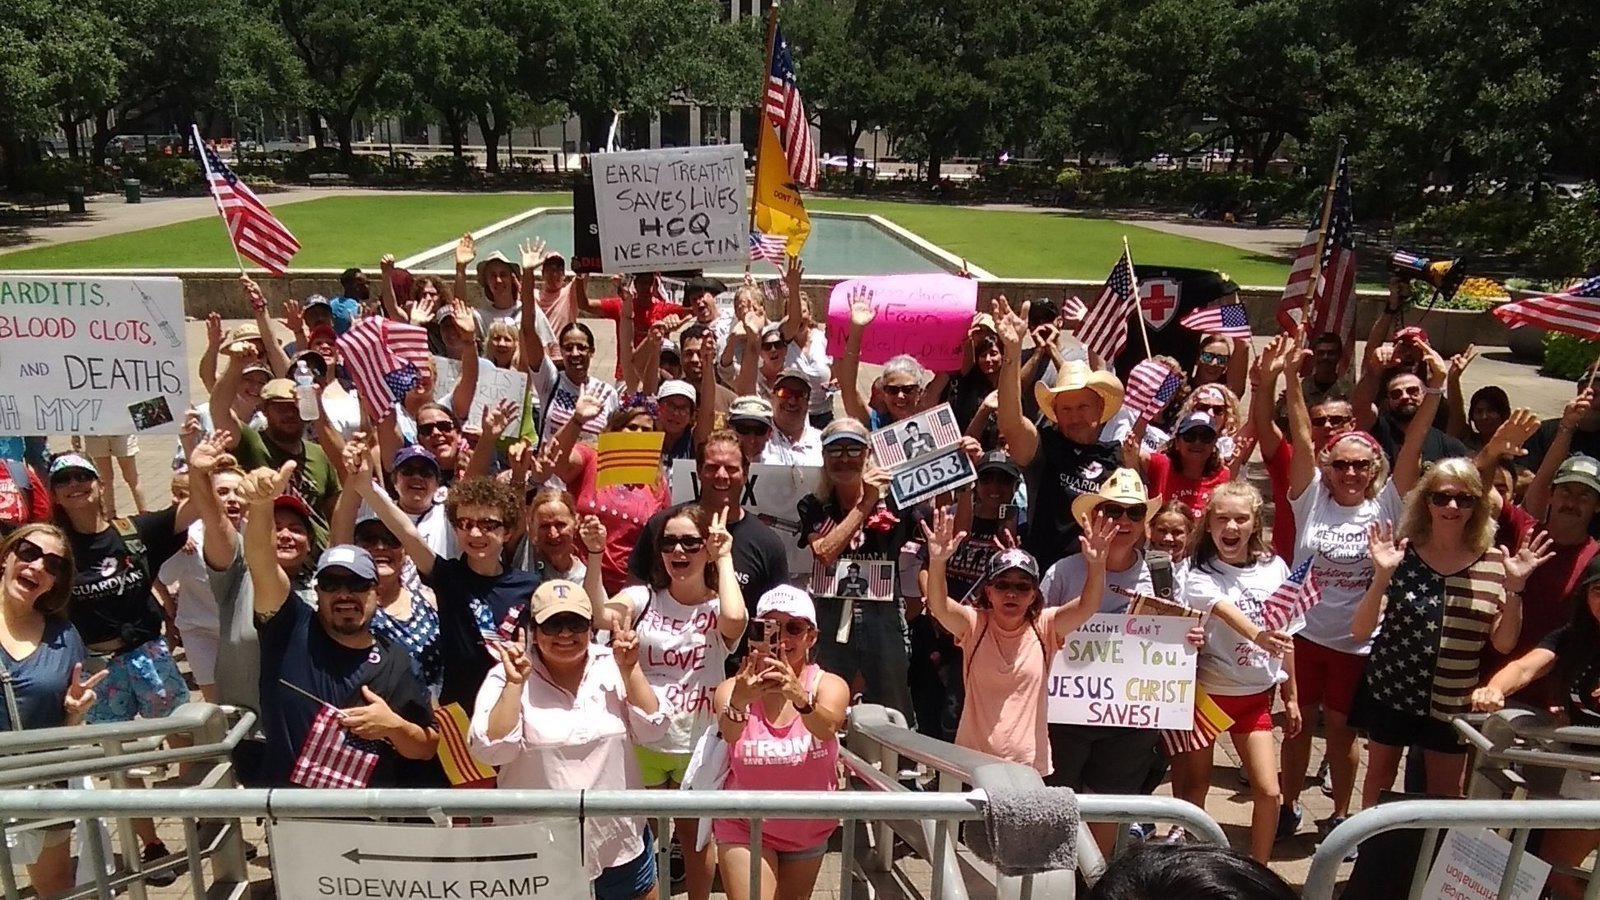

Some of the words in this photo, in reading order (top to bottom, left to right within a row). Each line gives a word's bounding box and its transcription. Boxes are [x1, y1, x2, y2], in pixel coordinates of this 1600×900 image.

[606, 163, 661, 185] EARLY
[616, 188, 688, 215] SAVES
[639, 212, 711, 239] HCQ
[613, 234, 740, 262] IVERMECTIN
[0, 316, 77, 339] BLOOD
[89, 319, 157, 346] CLOTS,
[19, 362, 50, 378] AND
[64, 354, 183, 395] DEATHS,
[0, 394, 21, 431] H
[34, 394, 103, 432] MY!
[901, 455, 961, 494] 7053
[1059, 472, 1101, 492] GUARDI
[72, 569, 144, 596] GUARDIANS
[647, 643, 707, 672] LOVE
[1068, 639, 1125, 664] SAVE
[1047, 675, 1115, 700] JESUS
[1124, 677, 1192, 704] CHRIST
[1086, 701, 1161, 728] SAVES!
[742, 733, 824, 758] TRUMP
[318, 876, 460, 900] SIDEWALK
[470, 875, 550, 899] RAMP
